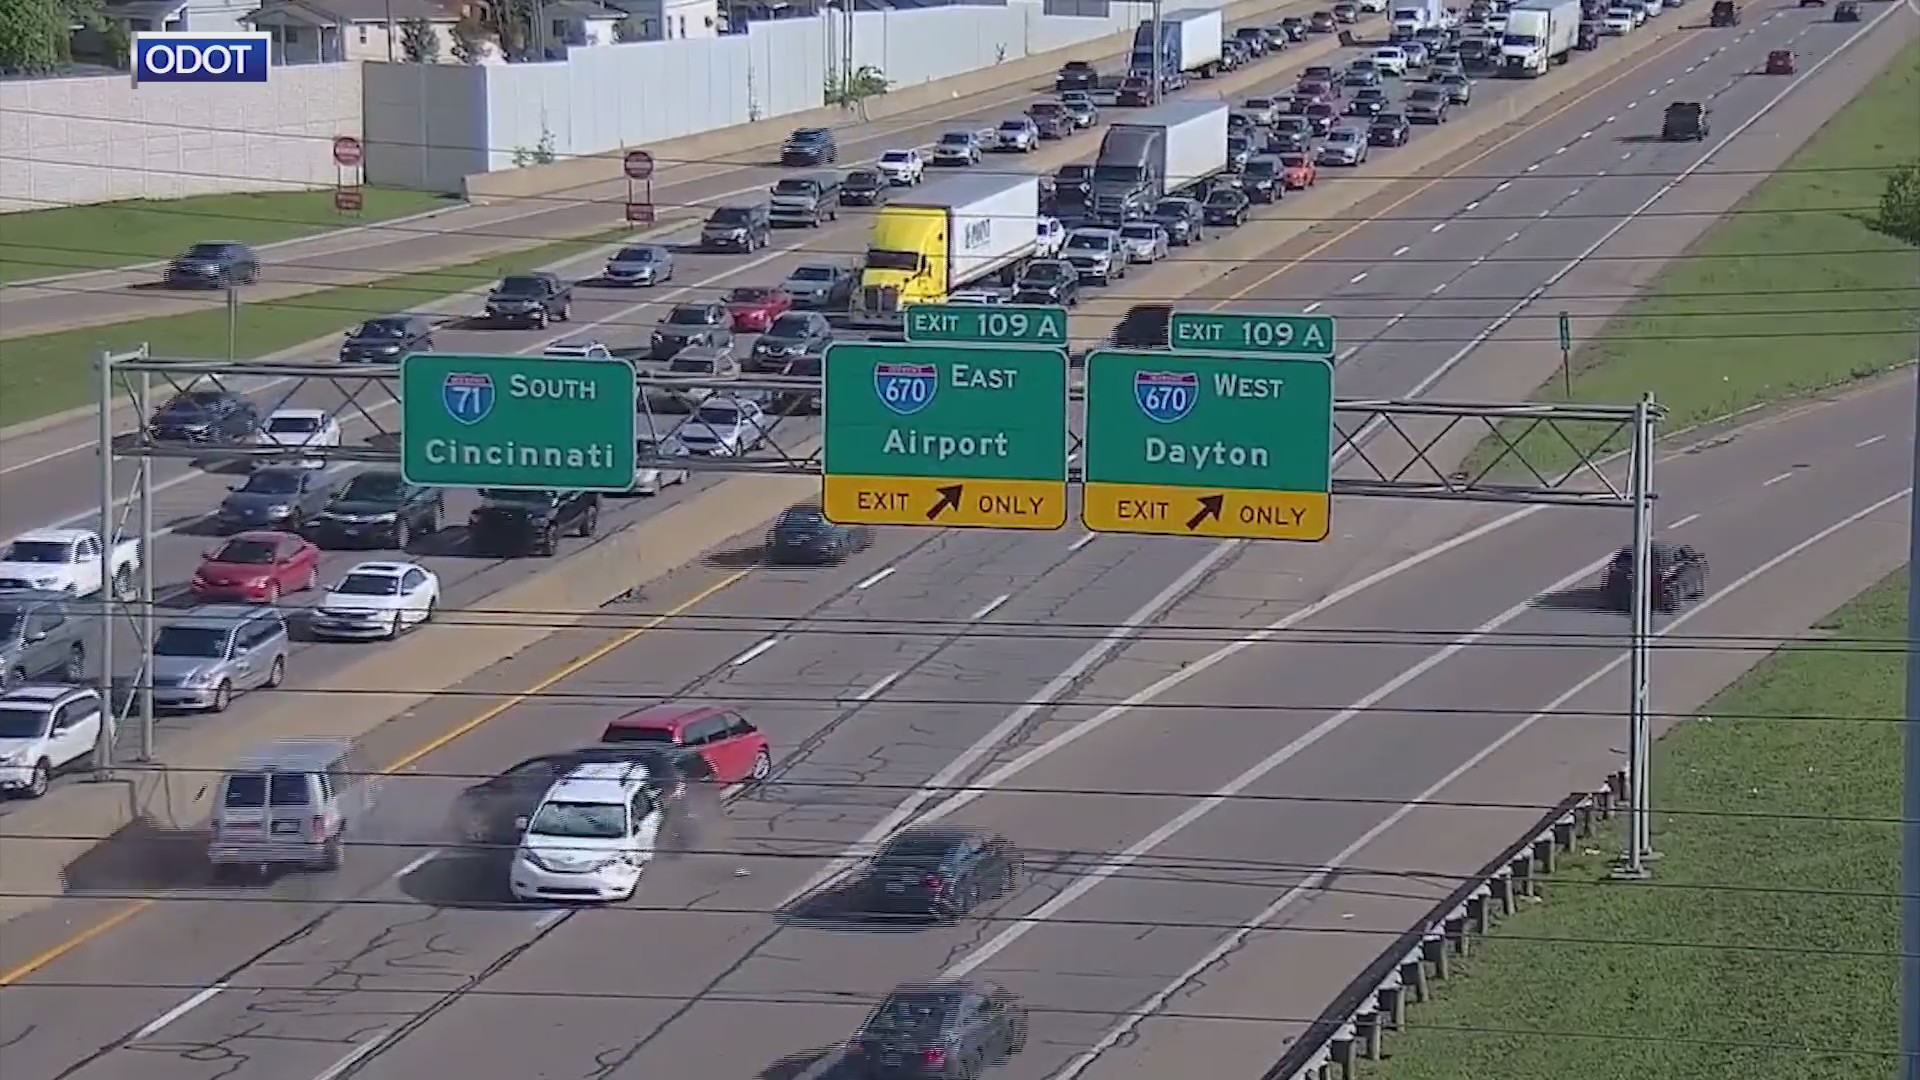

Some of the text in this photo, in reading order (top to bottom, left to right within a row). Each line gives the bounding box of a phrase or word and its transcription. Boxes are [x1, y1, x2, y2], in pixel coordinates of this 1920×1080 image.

[914, 313, 1059, 339] EXIT 109 A
[1178, 322, 1325, 348] EXIT 109 A
[510, 373, 597, 400] SOUTH
[885, 378, 926, 402] 670
[951, 364, 1018, 389] EAST
[1213, 372, 1284, 399] WEST
[453, 386, 480, 414] 71
[1146, 387, 1187, 412] 670
[425, 439, 614, 468] Cincinnati
[882, 429, 1008, 460] Airport
[1145, 437, 1268, 470] Dayton
[857, 492, 1045, 515] EXIT ONLY
[1118, 500, 1307, 527] EXIT ONLY
